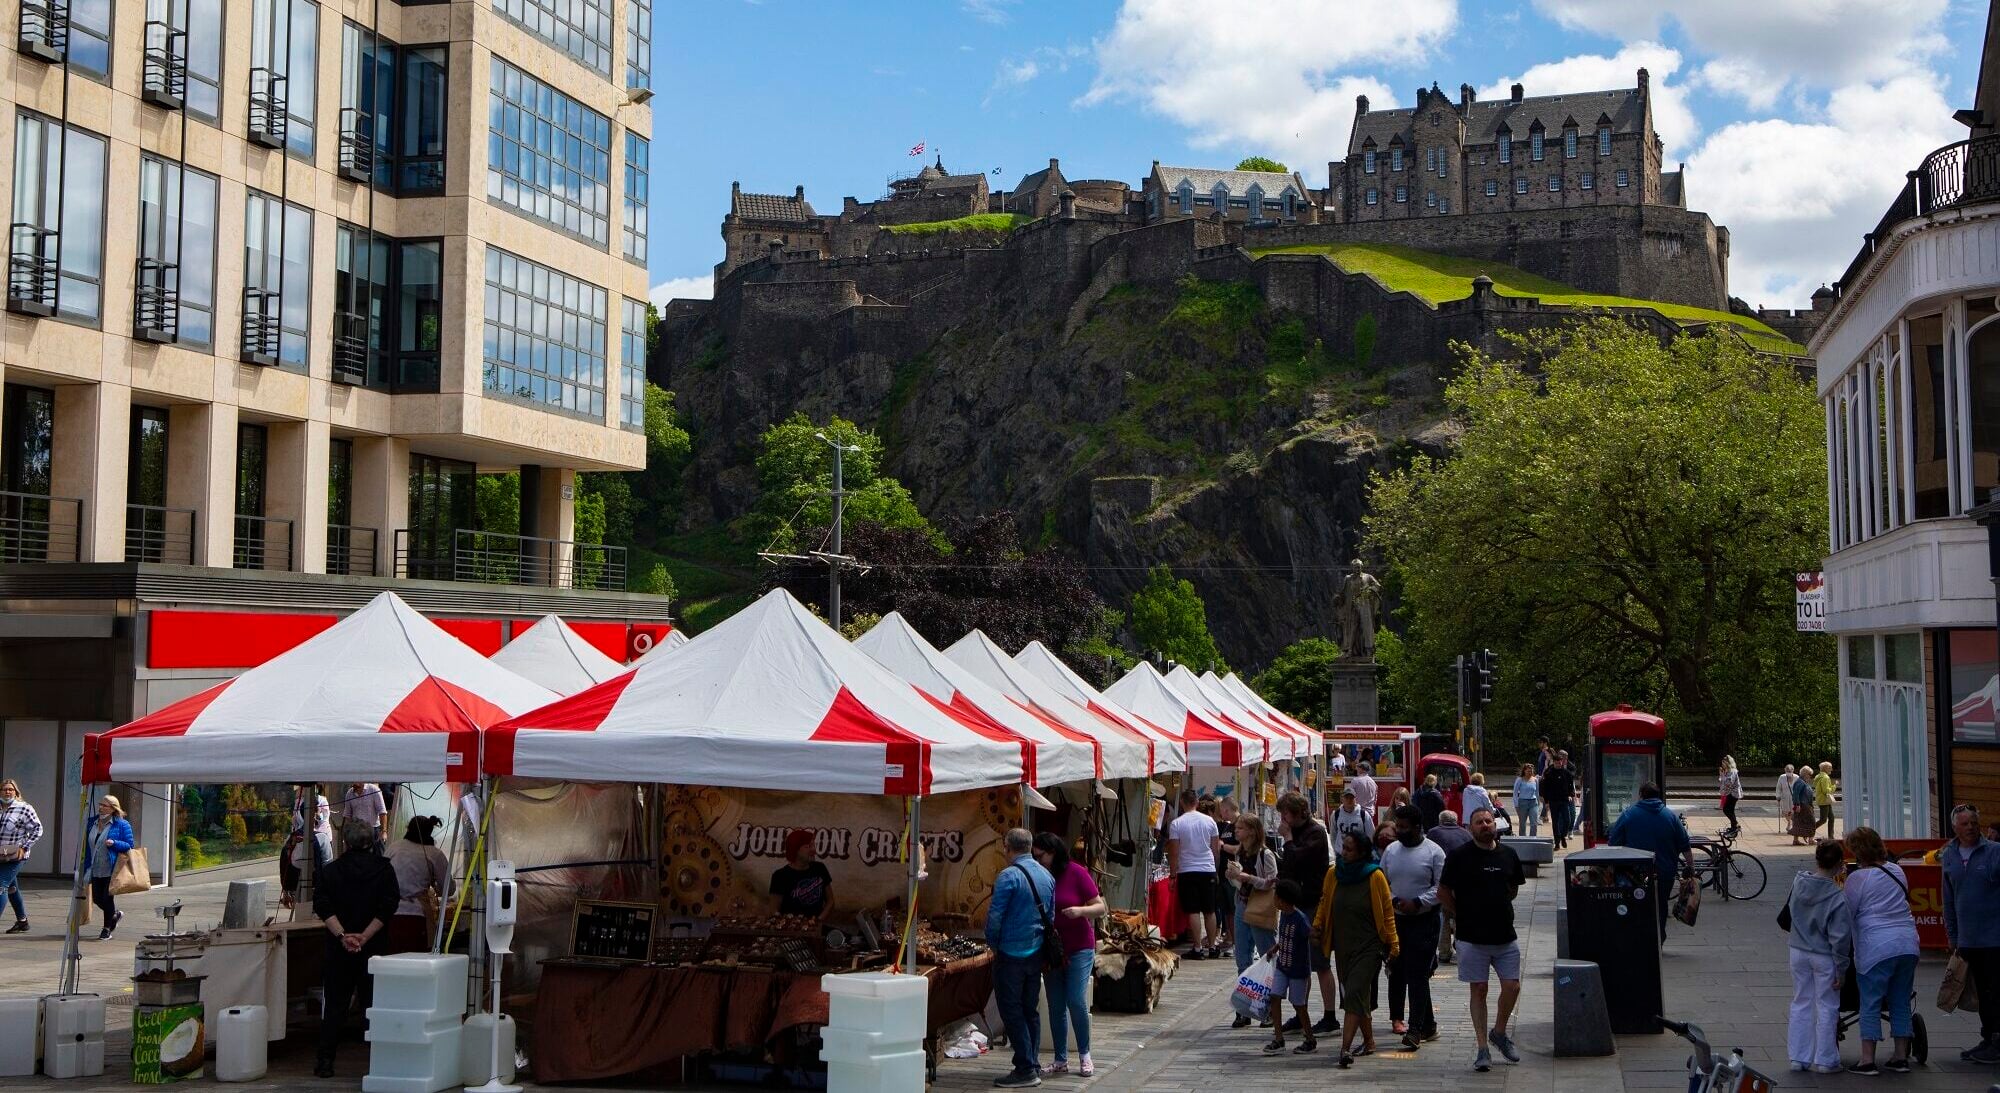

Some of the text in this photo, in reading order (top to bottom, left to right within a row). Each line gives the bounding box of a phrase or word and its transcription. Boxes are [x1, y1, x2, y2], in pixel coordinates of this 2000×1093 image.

[1797, 603, 1812, 617] TO
[728, 822, 851, 861] JOHON
[1597, 892, 1623, 900] LITTER
[1914, 916, 1937, 925] AKE
